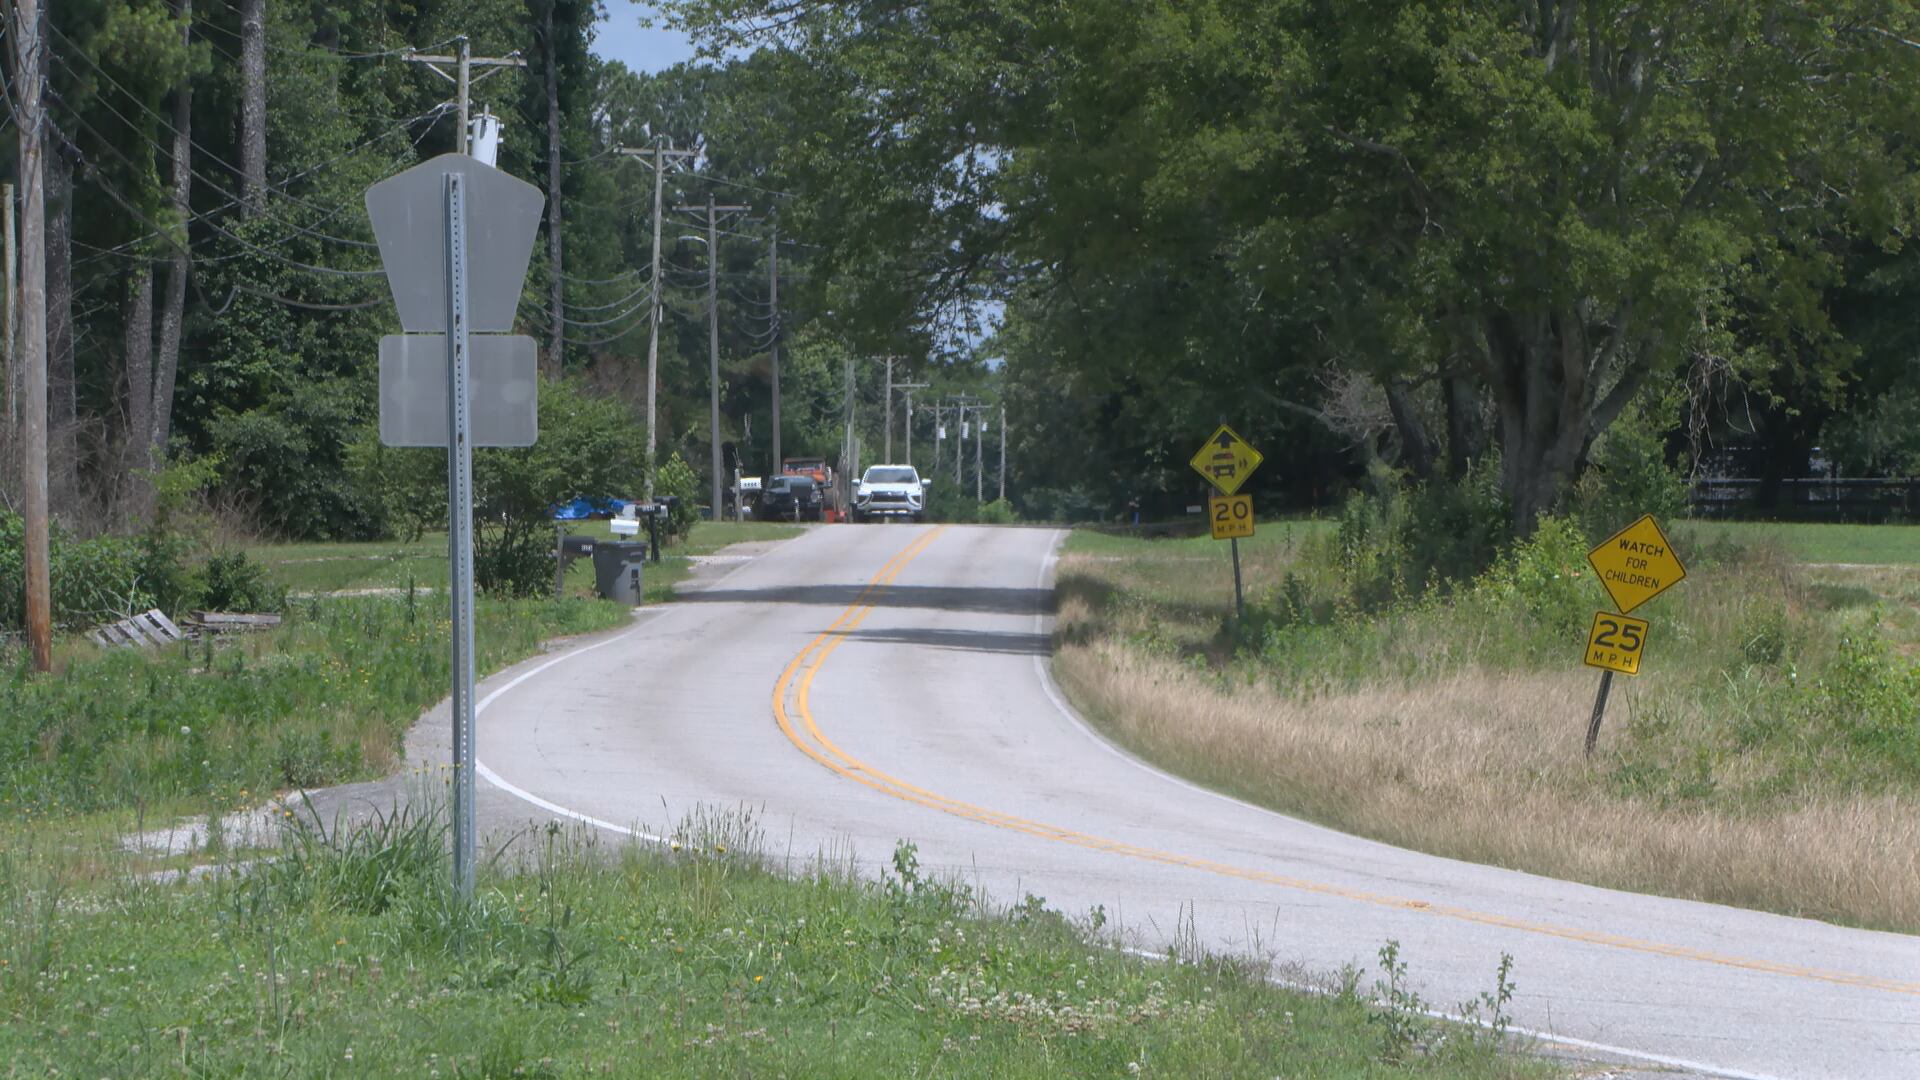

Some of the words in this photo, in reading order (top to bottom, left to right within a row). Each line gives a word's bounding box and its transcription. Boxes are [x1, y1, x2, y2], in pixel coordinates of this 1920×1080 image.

[1215, 501, 1248, 522] 20
[1620, 539, 1664, 557] WATCH
[1625, 556, 1648, 571] FOR
[1605, 569, 1660, 589] CHILDREN
[1595, 620, 1641, 652] 25
